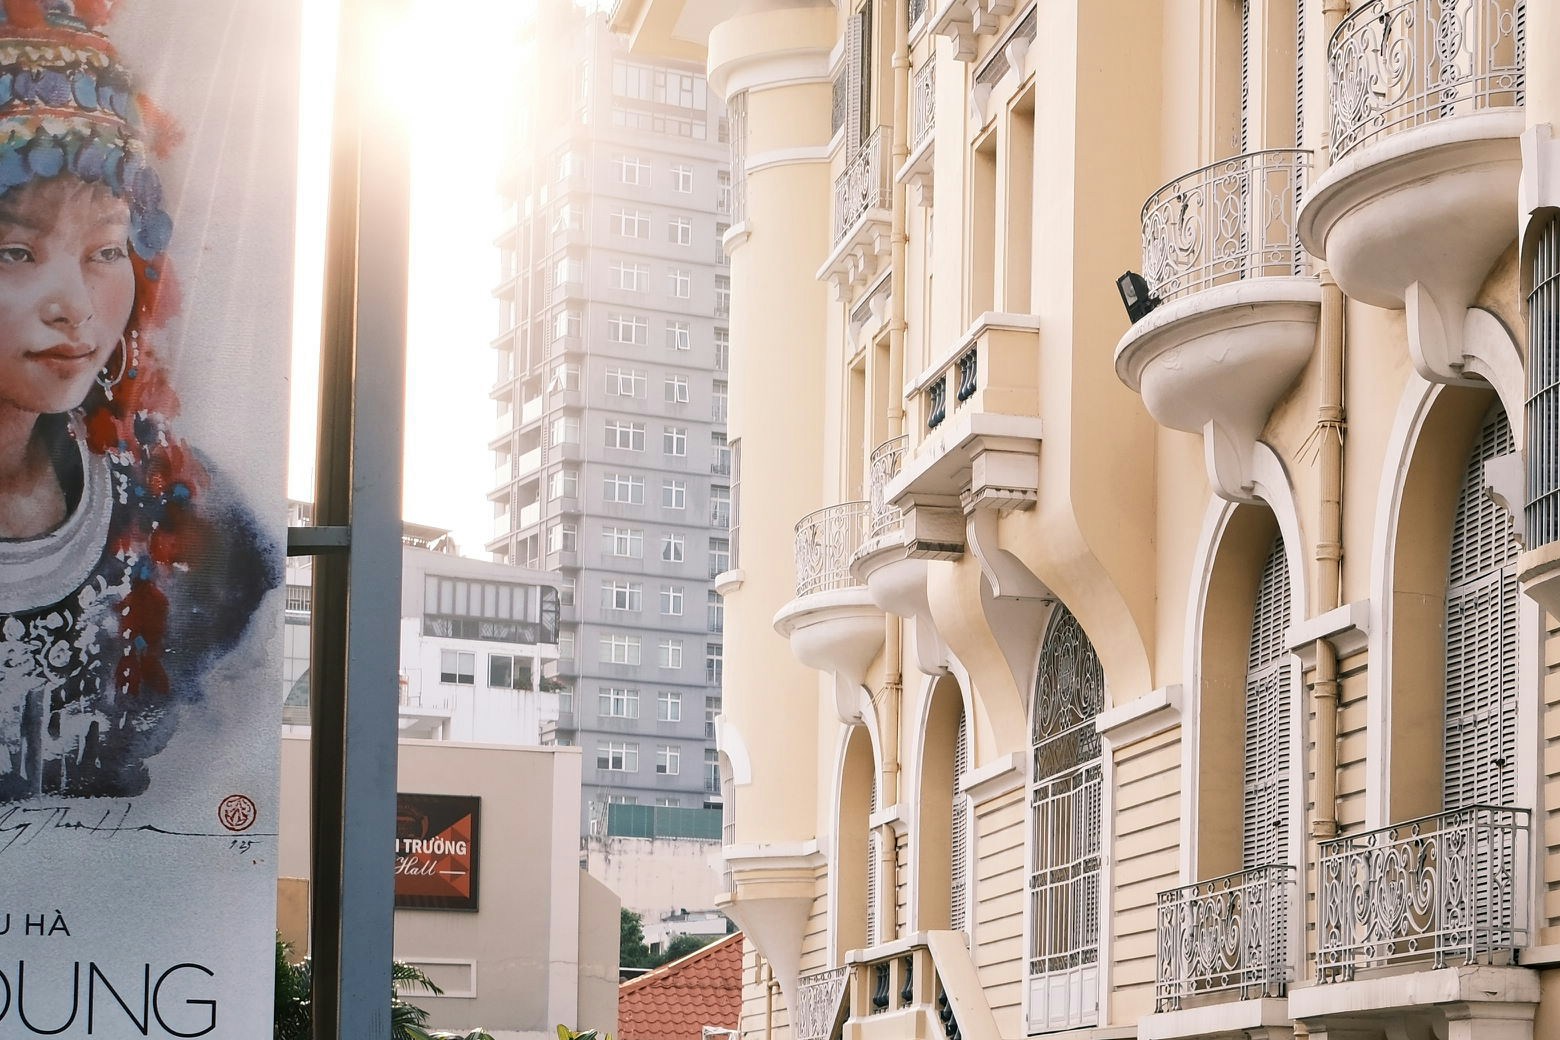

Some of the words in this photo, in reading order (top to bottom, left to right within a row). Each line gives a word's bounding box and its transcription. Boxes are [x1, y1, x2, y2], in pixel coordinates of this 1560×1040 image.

[403, 836, 467, 855] TRƯỜNG
[395, 856, 438, 876] Hall
[25, 909, 71, 937] HÀ
[0, 960, 217, 1039] UNG
